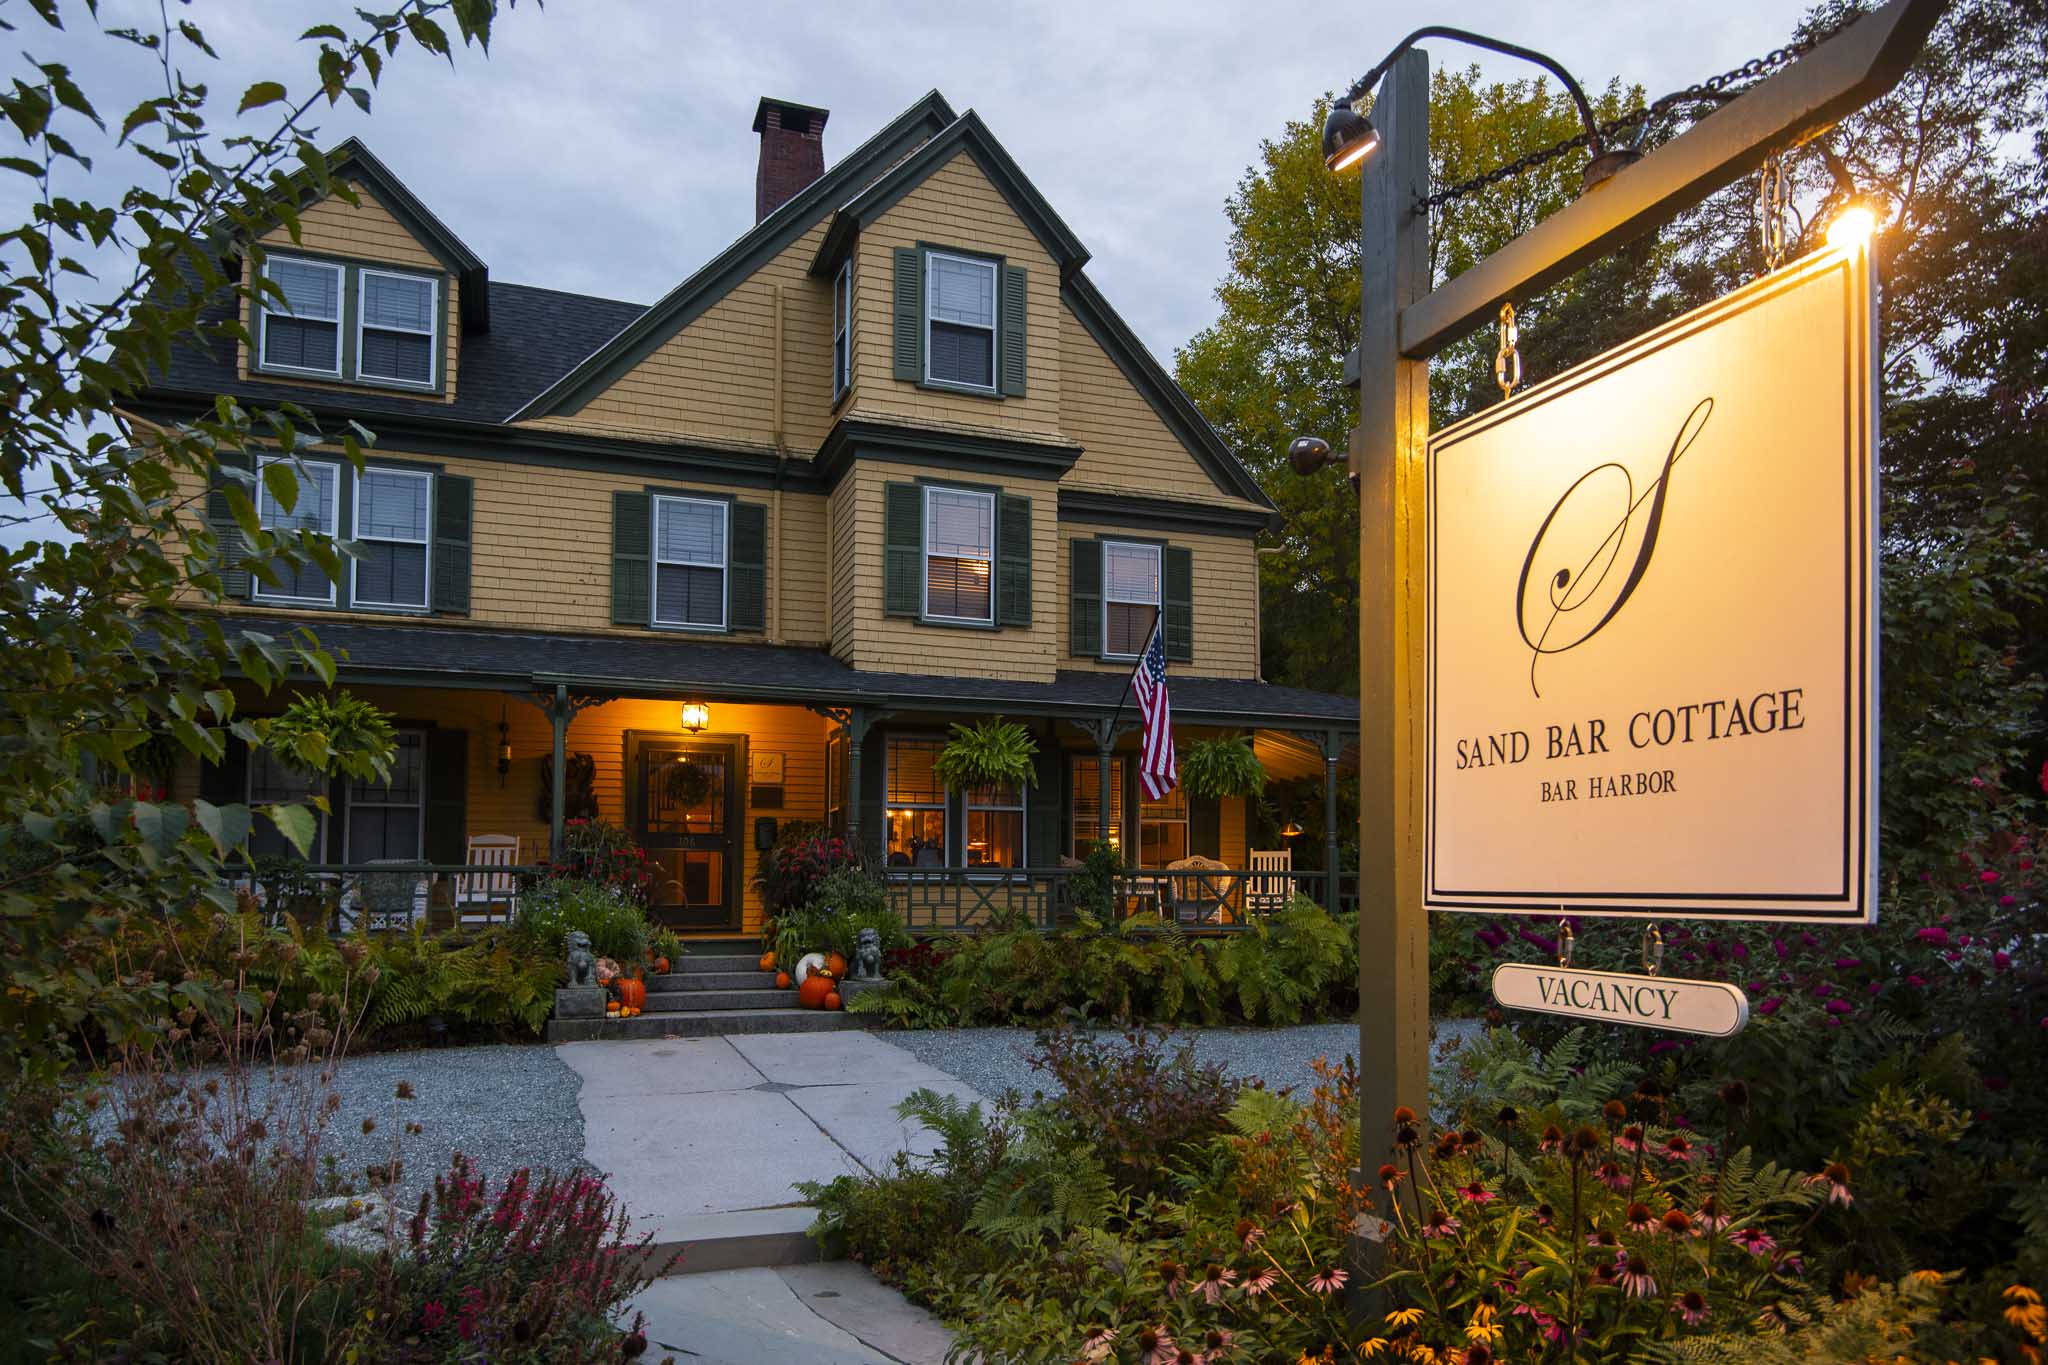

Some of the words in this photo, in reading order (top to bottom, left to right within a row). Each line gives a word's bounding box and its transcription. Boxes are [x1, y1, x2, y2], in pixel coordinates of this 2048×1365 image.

[1456, 730, 1529, 770] SAND
[1546, 719, 1609, 760] BAR
[1629, 688, 1806, 749] COTTAGE
[1541, 780, 1579, 802] BAR
[1589, 770, 1678, 799] HARBOR
[1537, 976, 1679, 1019] VACANCY
